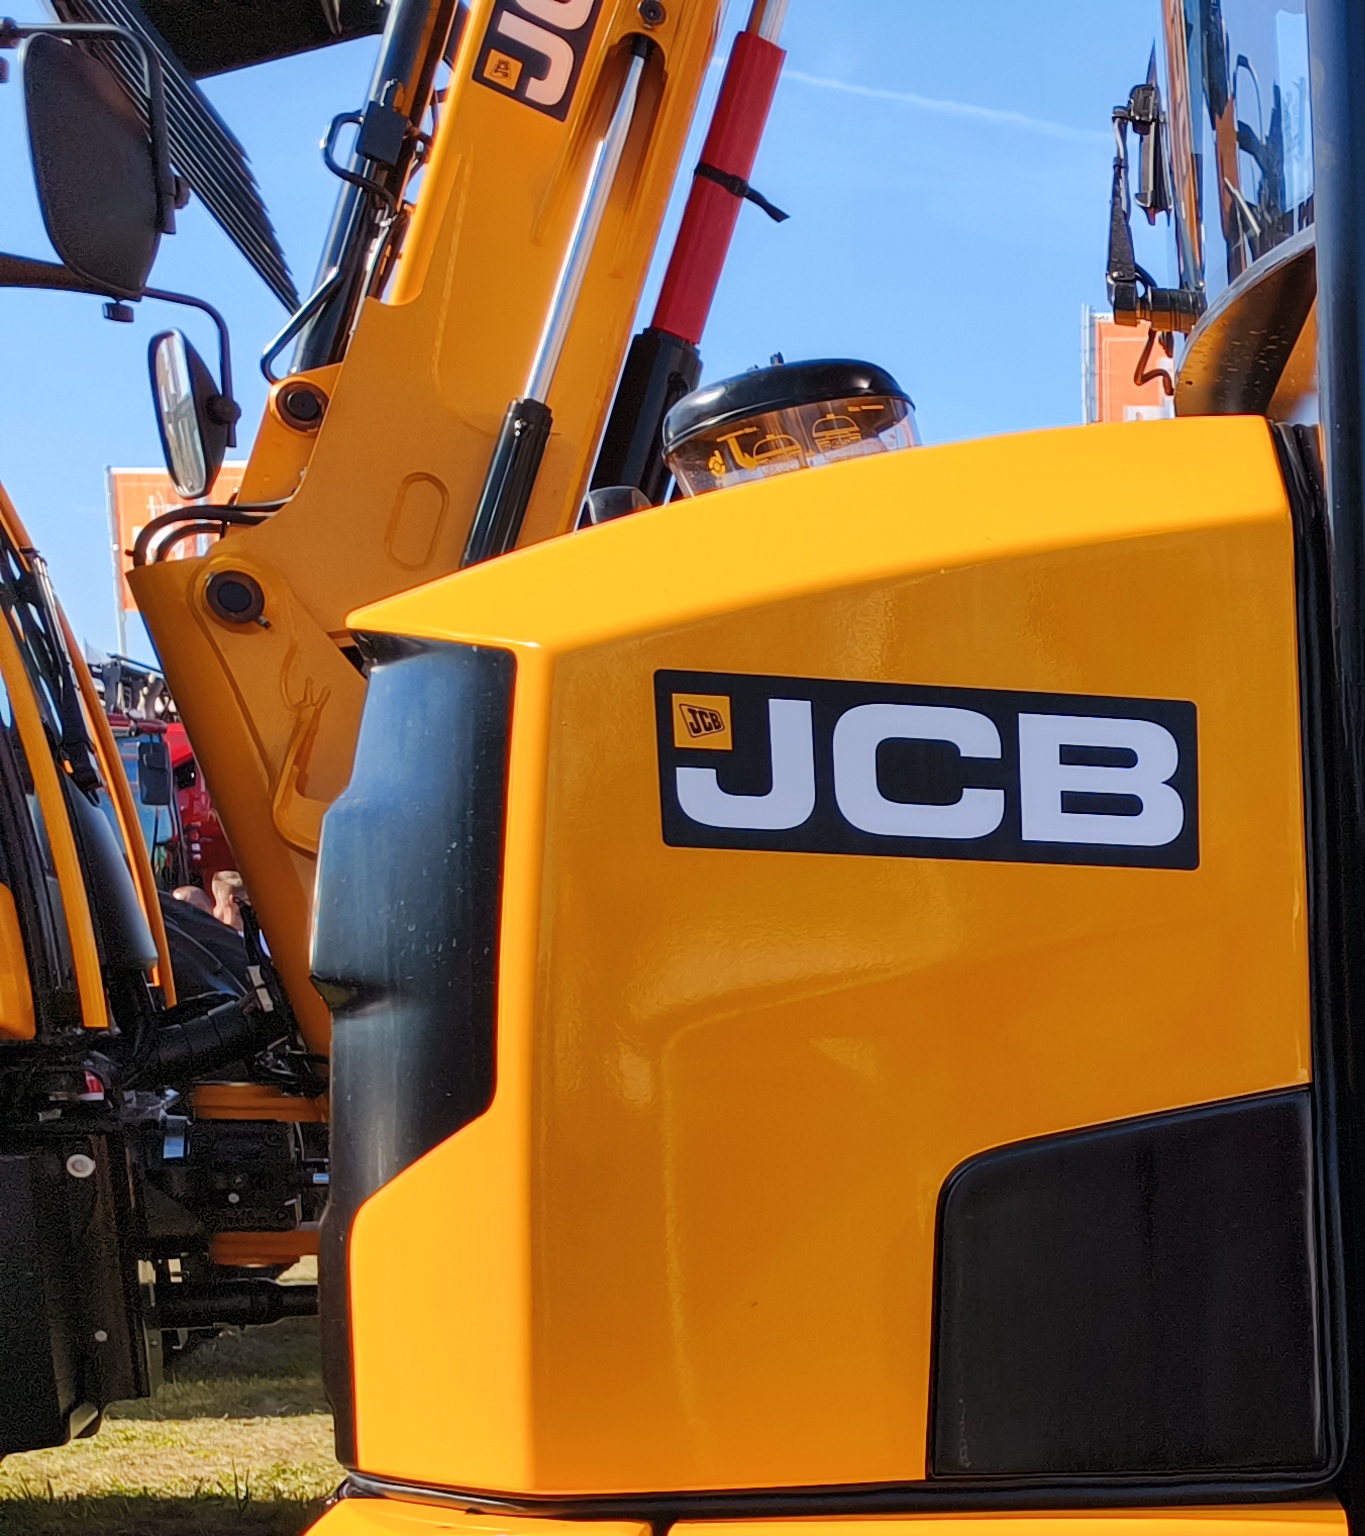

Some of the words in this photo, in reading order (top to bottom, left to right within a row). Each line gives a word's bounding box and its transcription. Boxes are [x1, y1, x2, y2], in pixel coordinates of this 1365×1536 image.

[498, 0, 594, 106] J
[676, 698, 1184, 847] JCB
[688, 707, 722, 735] JCB
